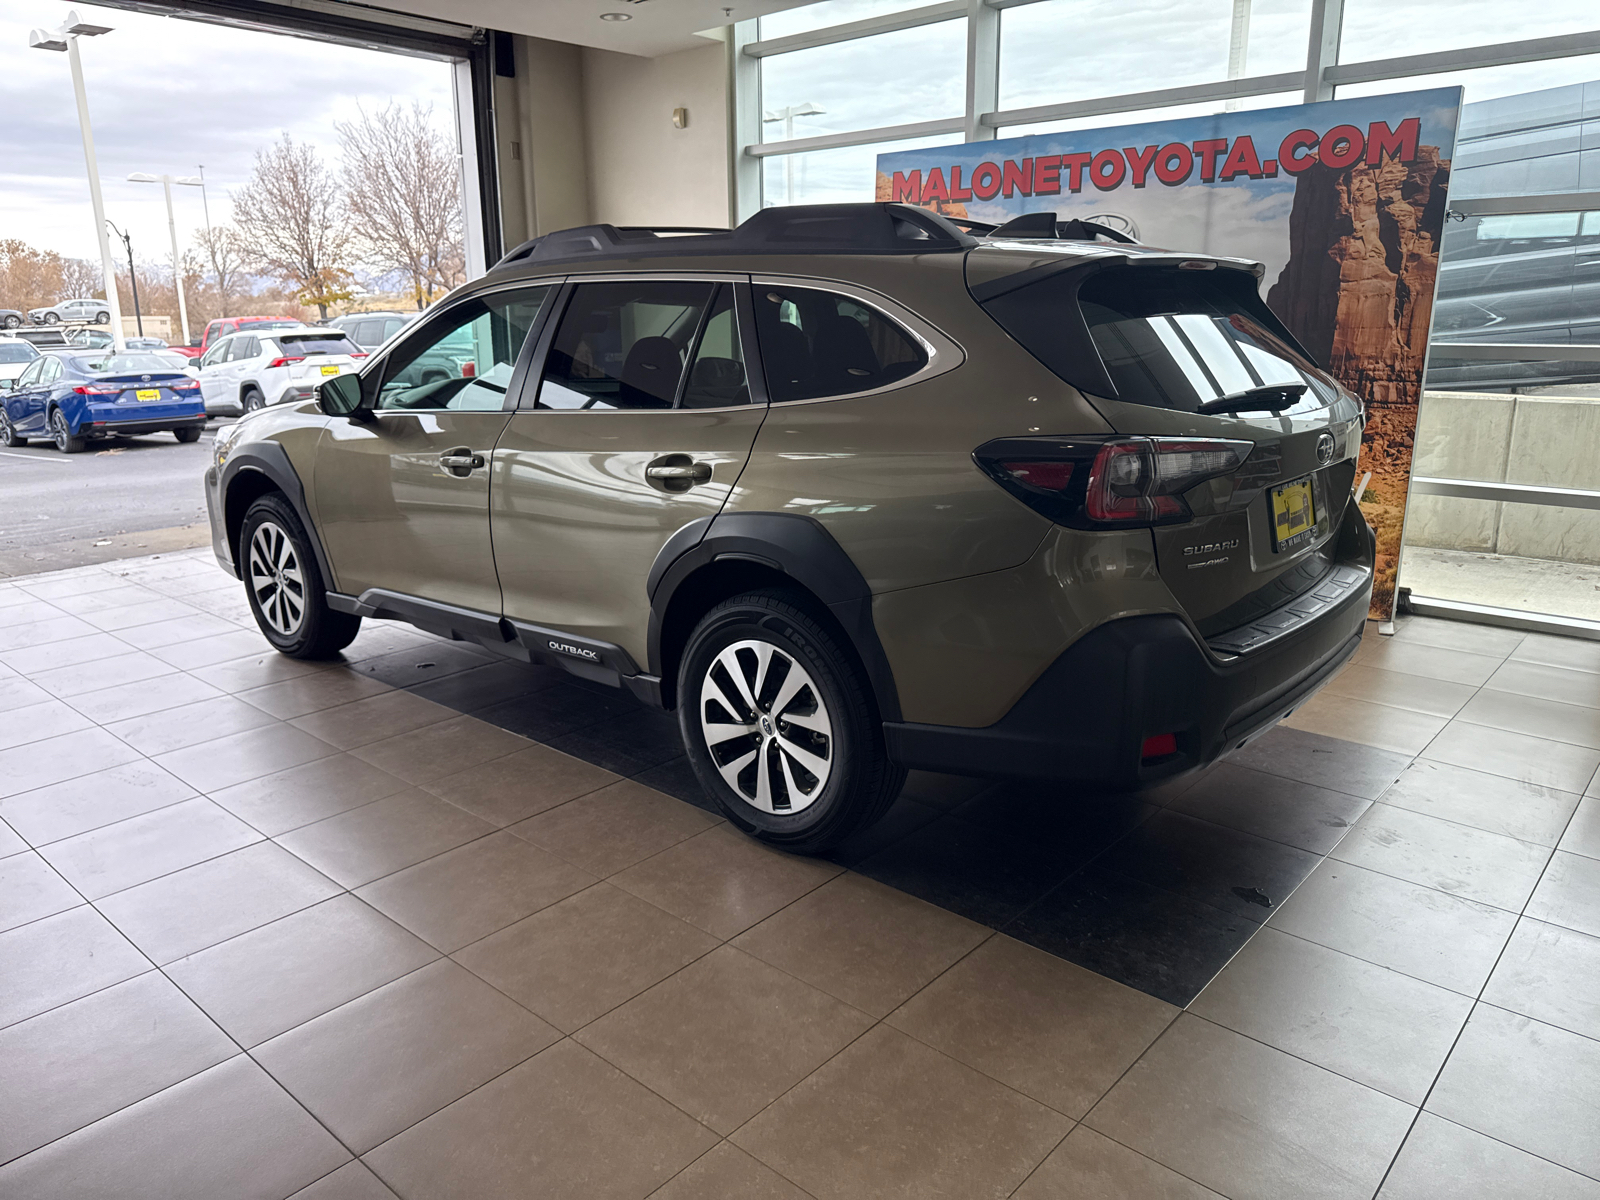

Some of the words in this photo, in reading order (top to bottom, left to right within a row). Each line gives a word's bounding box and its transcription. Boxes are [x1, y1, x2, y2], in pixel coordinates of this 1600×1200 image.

[892, 117, 1422, 204] MALONETOYOTA.COM
[1183, 539, 1239, 556] SUBARU
[548, 641, 598, 660] OUTBACK
